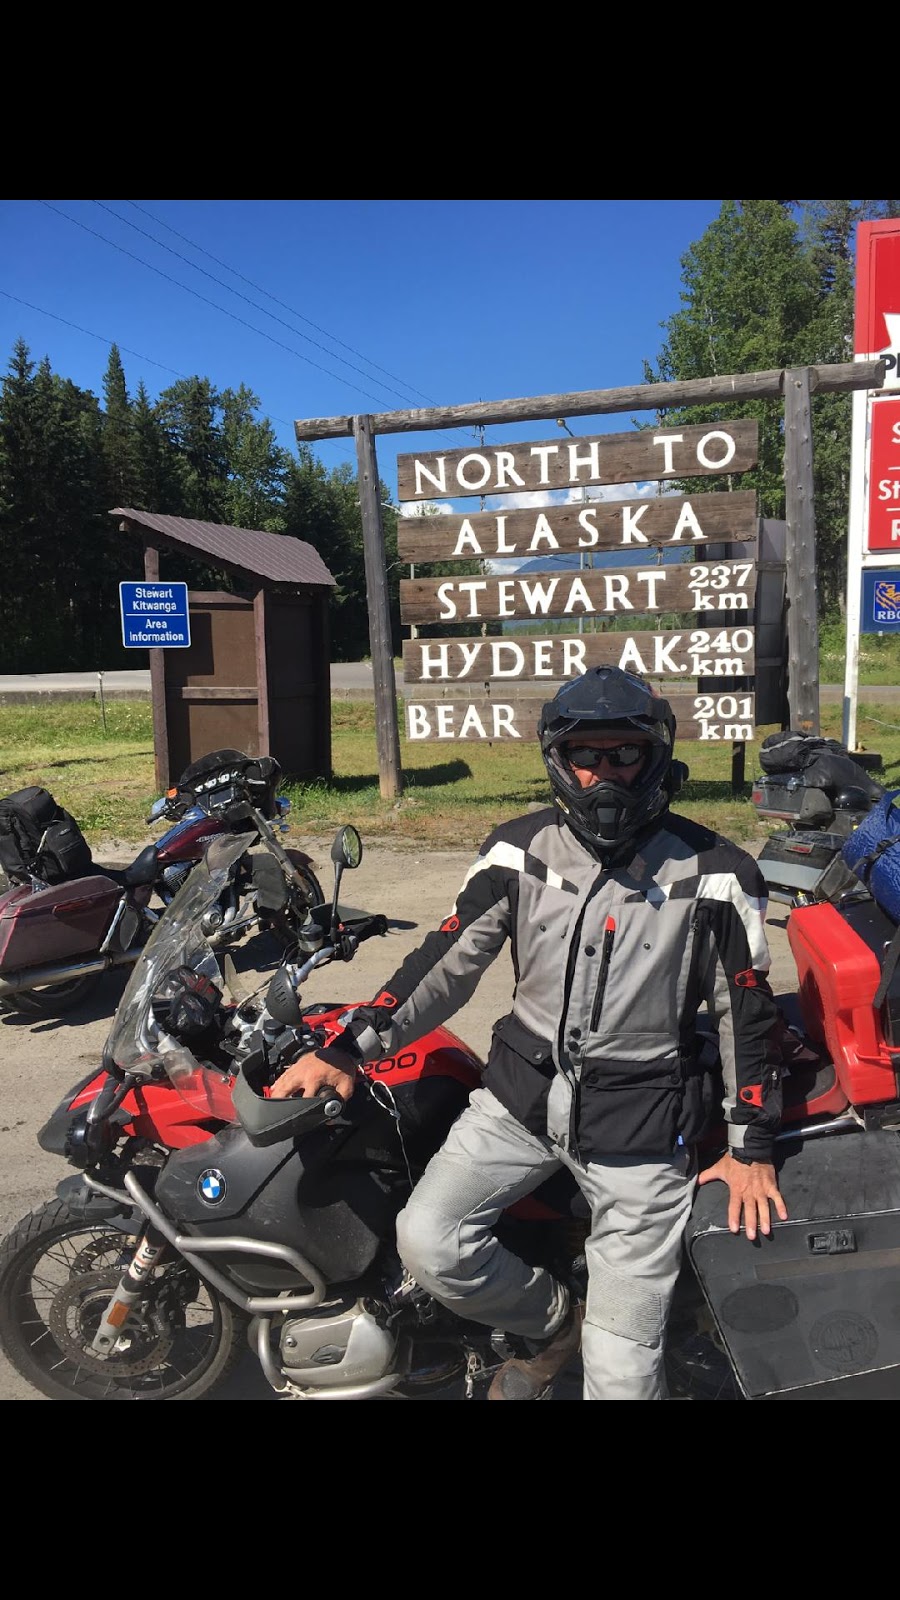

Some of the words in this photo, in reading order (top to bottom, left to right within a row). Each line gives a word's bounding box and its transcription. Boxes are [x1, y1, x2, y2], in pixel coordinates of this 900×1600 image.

[880, 353, 900, 378] P
[413, 441, 602, 495] NORTH
[652, 430, 737, 474] TO
[451, 501, 708, 555] ALASKA
[135, 587, 173, 598] Stewart
[436, 570, 667, 620] STEWART
[687, 563, 753, 590] 237
[691, 589, 749, 612] km
[132, 600, 177, 612] Kitwanga
[145, 619, 168, 629] Area
[129, 631, 184, 642] Information
[418, 638, 588, 680] HYDER
[617, 634, 688, 675] AK.
[687, 629, 754, 654] 240
[690, 654, 746, 677] km
[407, 702, 522, 740] BEAR
[692, 694, 754, 721] 201
[698, 719, 754, 741] km
